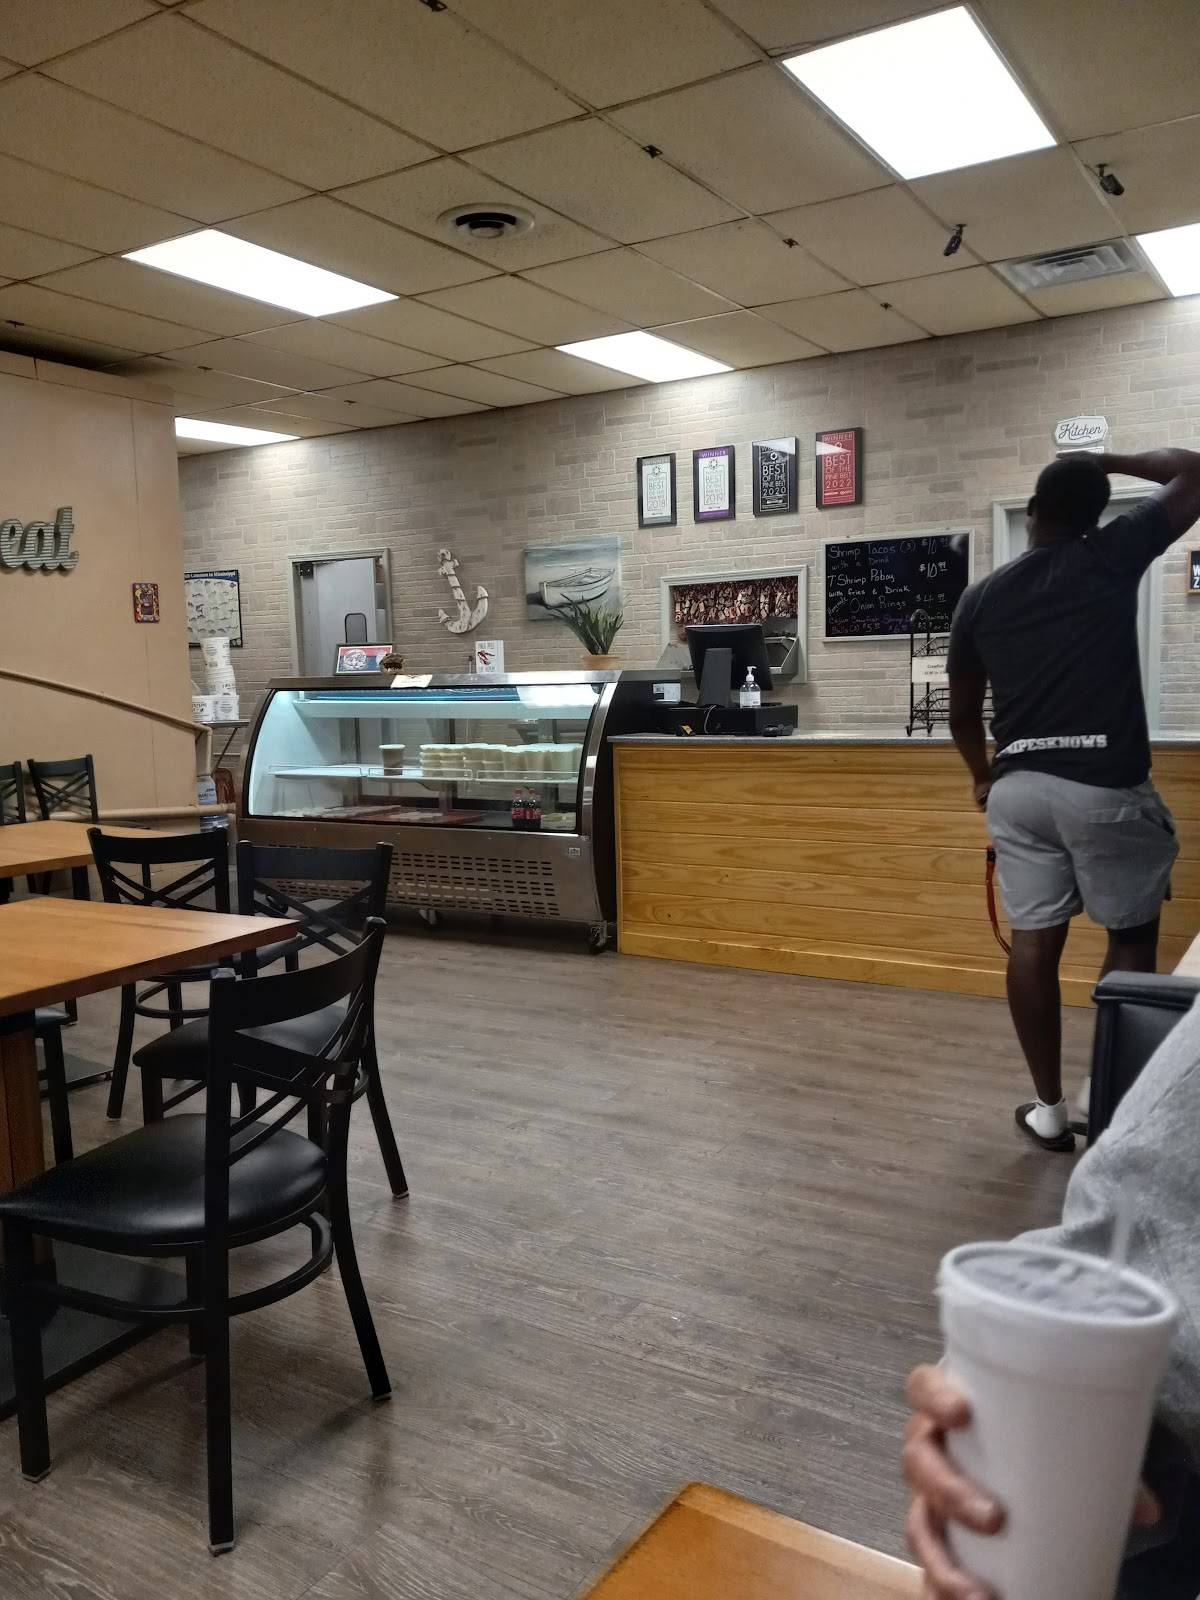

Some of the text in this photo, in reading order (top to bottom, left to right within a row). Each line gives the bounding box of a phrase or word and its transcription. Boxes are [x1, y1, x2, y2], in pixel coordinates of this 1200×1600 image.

[1059, 423, 1102, 440] Kitchen
[702, 450, 726, 458] WINNER
[825, 453, 850, 467] BEST
[762, 463, 785, 476] BEST
[838, 464, 851, 473] THE
[762, 473, 786, 483] OF THE
[826, 479, 852, 489] 2022
[762, 486, 787, 496] 2020
[705, 493, 724, 503] 2019
[648, 499, 666, 509] 2018
[0, 506, 79, 570] eat
[828, 545, 860, 559] Shrimp
[865, 542, 896, 555] Tacos
[837, 573, 867, 586] Shrimp
[848, 588, 866, 596] fries
[884, 585, 911, 594] Drink
[879, 595, 906, 609] Rings
